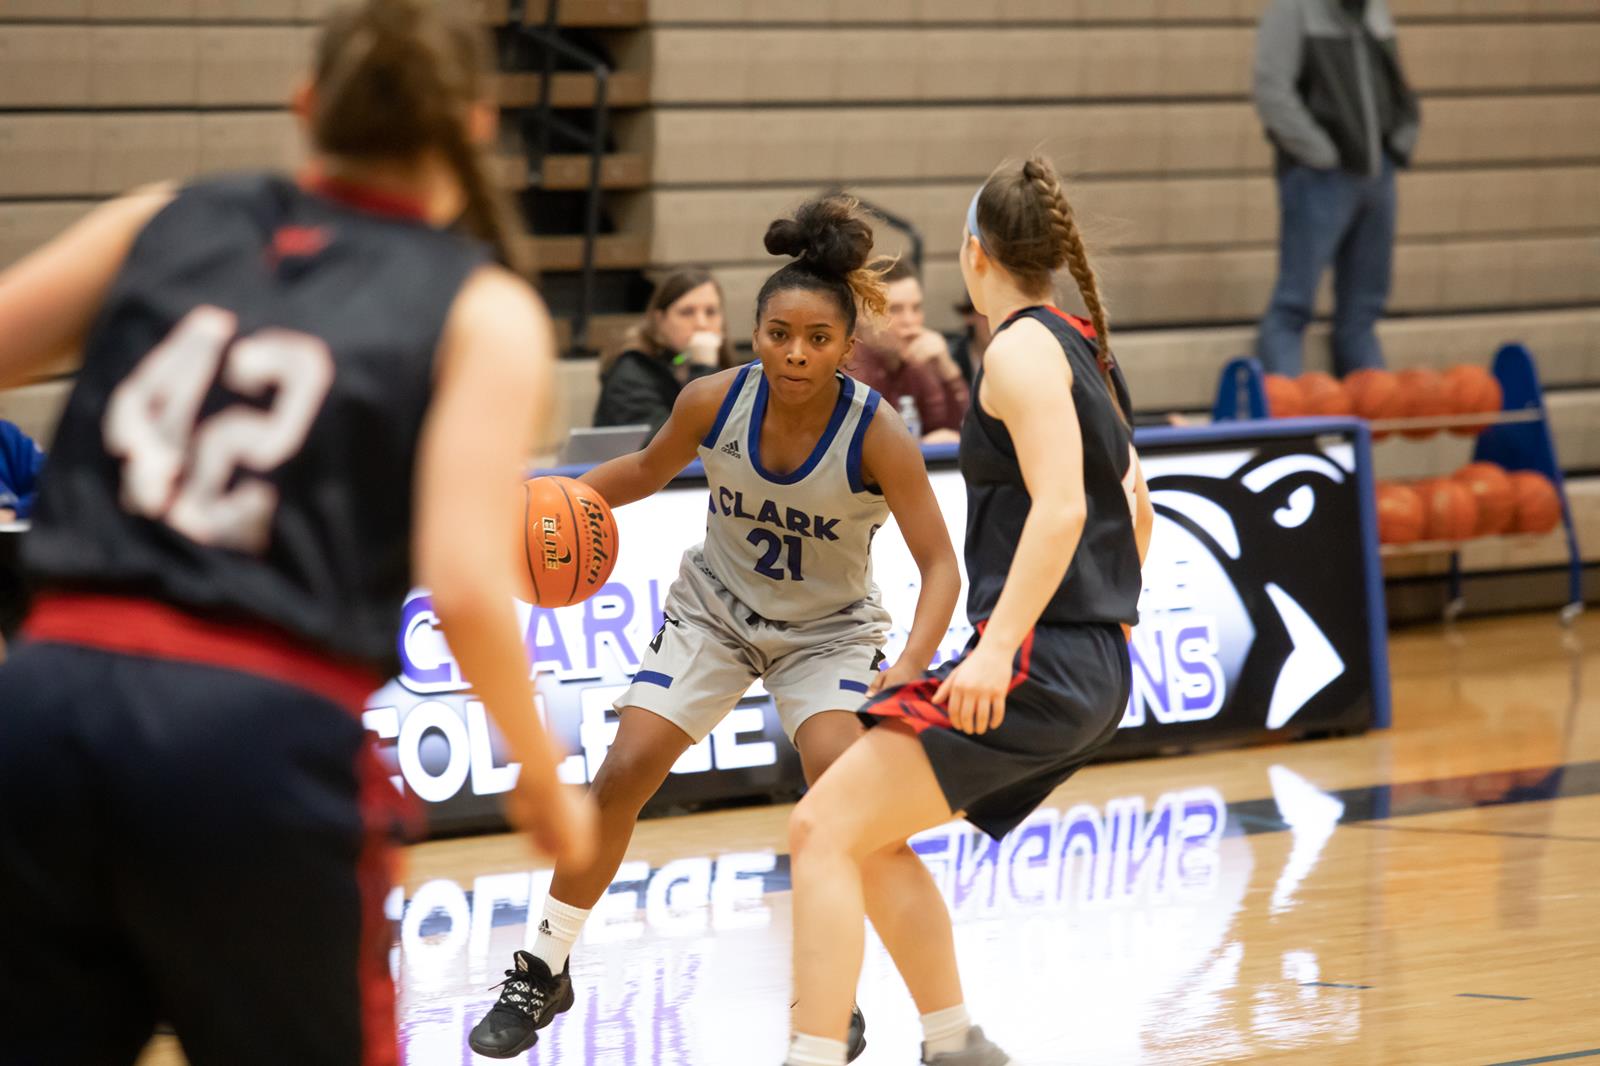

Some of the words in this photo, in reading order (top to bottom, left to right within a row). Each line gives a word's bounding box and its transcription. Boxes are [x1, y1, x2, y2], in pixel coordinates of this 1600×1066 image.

[102, 304, 336, 552] 42
[719, 486, 842, 541] CLARK
[542, 517, 560, 570] ELITE
[746, 527, 804, 581] 21
[396, 578, 668, 684] CAR
